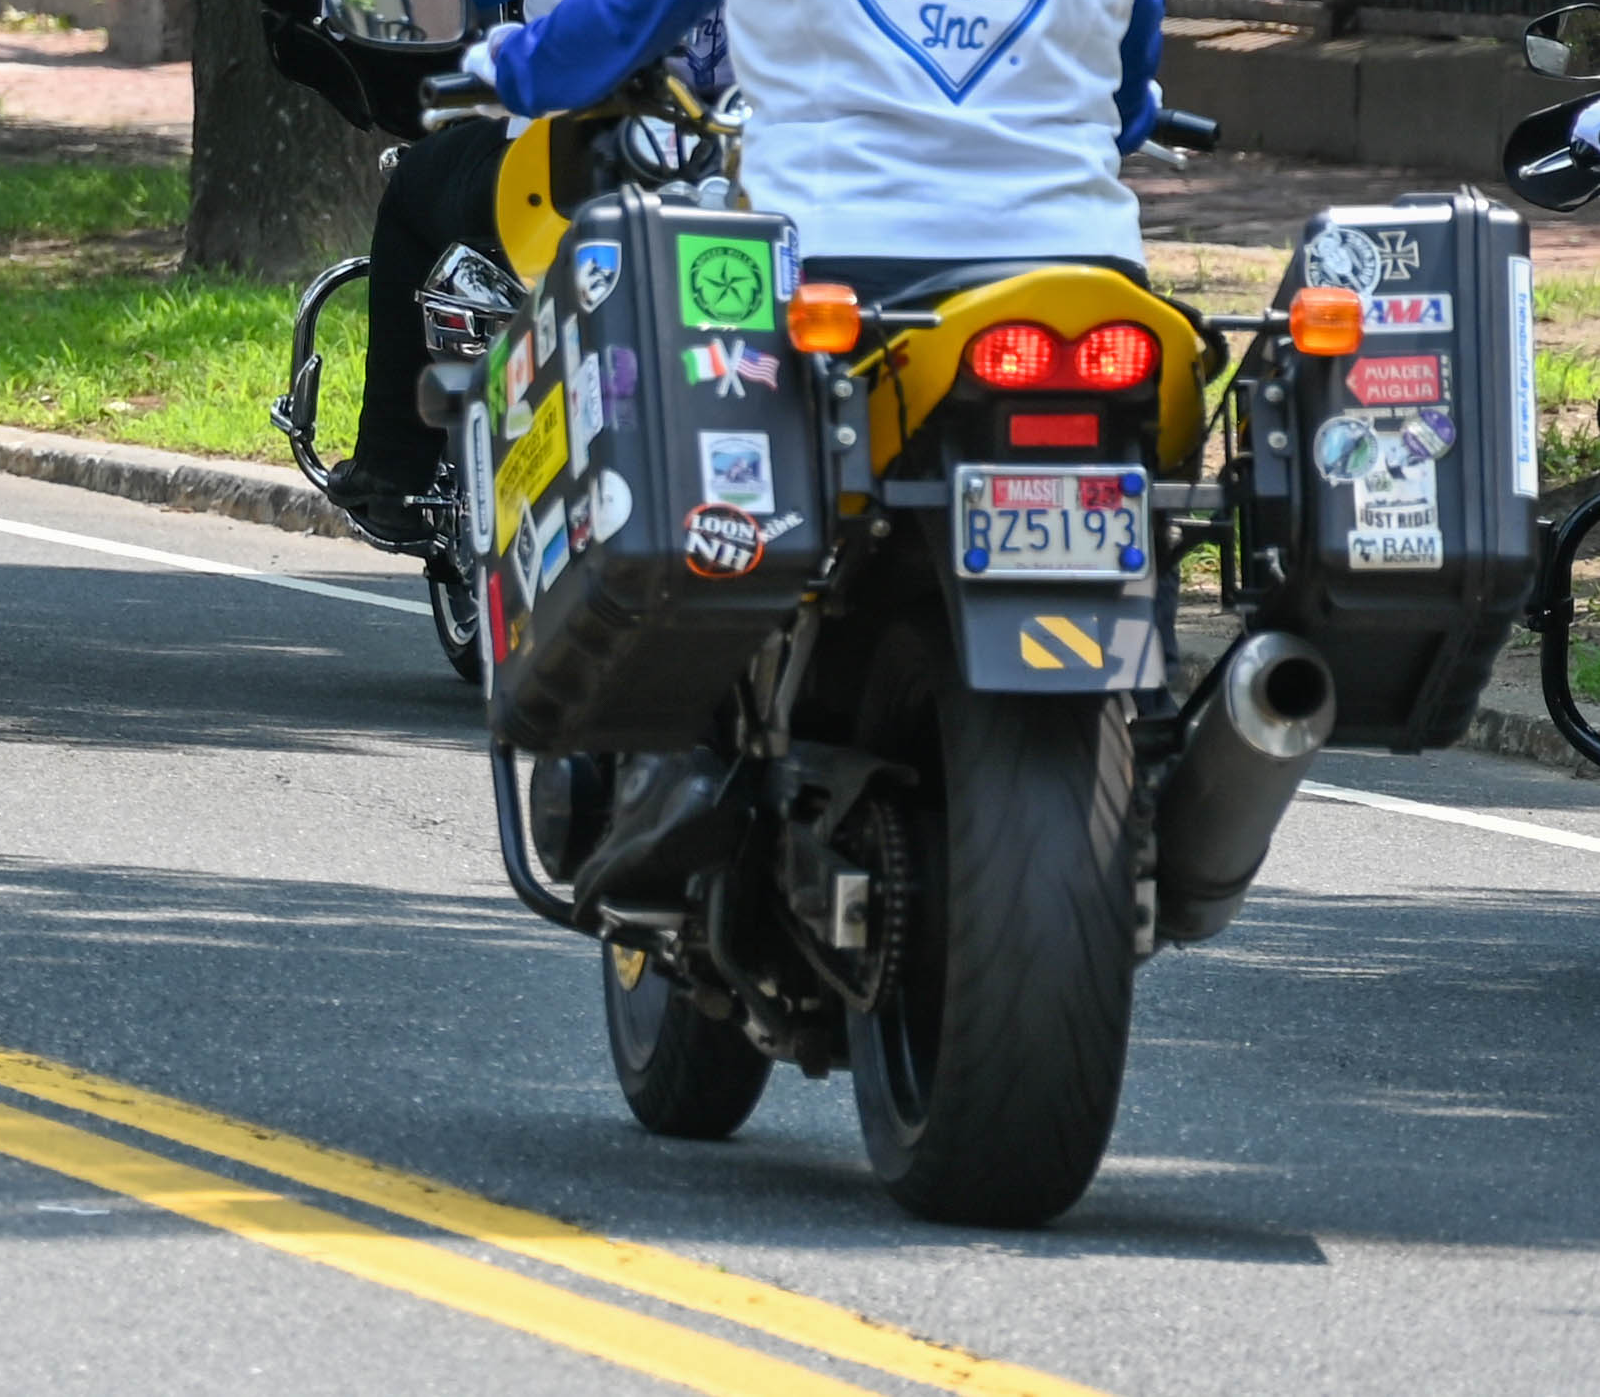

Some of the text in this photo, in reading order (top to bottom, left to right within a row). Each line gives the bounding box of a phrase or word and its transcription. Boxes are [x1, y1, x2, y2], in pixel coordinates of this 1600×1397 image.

[919, 2, 989, 50] Inc
[1365, 299, 1433, 324] AMA
[690, 514, 756, 542] LOON
[686, 529, 754, 572] NH
[1383, 536, 1436, 553] RAM
